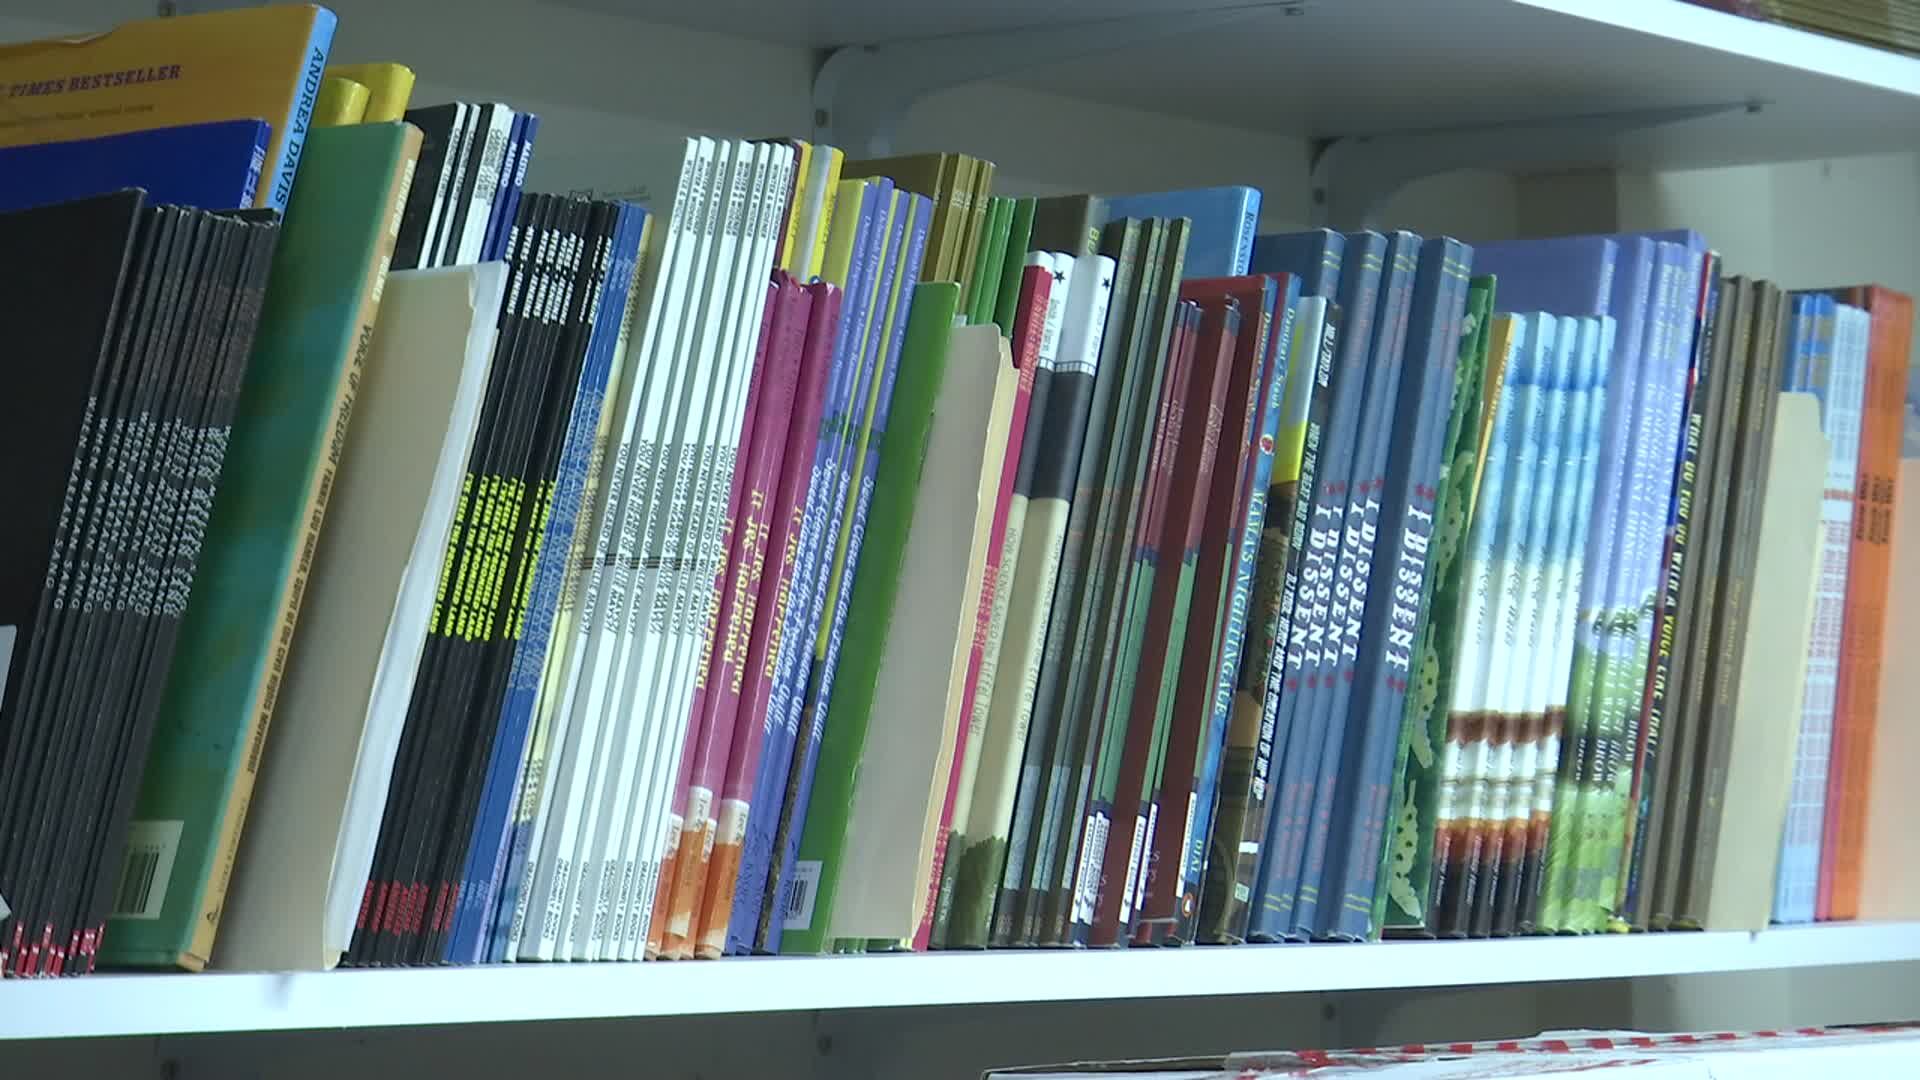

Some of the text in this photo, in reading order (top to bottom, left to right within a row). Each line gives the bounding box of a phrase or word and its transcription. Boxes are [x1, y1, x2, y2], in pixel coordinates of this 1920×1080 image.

[69, 64, 181, 91] BESTSELLER
[274, 46, 325, 205] ANDREA DAVIS
[501, 141, 518, 187] MAESTRO
[514, 139, 533, 187] MAESTRO
[1305, 421, 1320, 452] WHEN
[1685, 412, 1702, 455] WHAT
[617, 441, 629, 465] YOU
[660, 442, 671, 465] YOU
[702, 443, 714, 467] YOU
[1302, 451, 1316, 472] THE
[44, 394, 97, 589] WHEN MARIAN SANG
[609, 466, 624, 501] NEVER
[653, 466, 666, 501] NEVER
[695, 468, 709, 502] NEVER
[832, 469, 851, 516] Sweet
[855, 474, 874, 525] Sweet
[1298, 472, 1312, 498] BEAT
[52, 416, 108, 610] WHEN MARIAN SANG
[70, 416, 124, 610] WHEN MARIAN SANG
[82, 420, 136, 614] WHEN MARIAN SANG
[102, 420, 156, 613] WHEN MARIAN SANG
[115, 420, 171, 611] WHEN MARIAN SANG
[308, 508, 323, 531] LOU
[455, 494, 468, 522] SEEN
[471, 497, 483, 526] SEEN
[509, 503, 521, 531] SEEN
[601, 502, 616, 538] HEARD
[645, 502, 659, 539] HEARD
[687, 503, 702, 540] HEARD
[449, 523, 461, 545] THE
[465, 527, 476, 548] THE
[503, 532, 514, 553] THE
[598, 539, 608, 554] OF
[642, 540, 652, 554] OF
[684, 541, 694, 555] OF
[822, 517, 840, 562] Clara
[845, 523, 863, 570] Clara
[1003, 526, 1016, 555] HOW
[1290, 519, 1305, 552] BORN
[435, 545, 456, 601] PROMISED
[451, 548, 471, 605] PROMISED
[490, 553, 509, 609] PROMISED
[590, 555, 604, 591] WILLIE
[635, 556, 648, 591] WILLIE
[677, 557, 691, 592] WILLIE
[815, 562, 831, 594] and
[839, 568, 854, 600] and
[994, 555, 1010, 602] SCIENCE
[1284, 571, 1297, 589] DJ
[1284, 503, 1332, 670] I DISSENT
[1322, 501, 1365, 667] I DISSENT
[1341, 496, 1380, 661] I DISSENT
[427, 602, 441, 634] LAND
[809, 594, 824, 622] the
[833, 599, 848, 627] the
[1280, 588, 1295, 616] KOOL
[443, 605, 457, 638] LAND
[482, 610, 495, 641] LAND
[987, 603, 1002, 638] SAVED
[794, 622, 818, 690] Freedom
[1213, 568, 1250, 717] NIGHTINGALE
[1271, 645, 1286, 669] AND
[819, 628, 841, 696] Freedom
[1268, 670, 1282, 691] THE
[1260, 690, 1279, 742] CREATION
[1257, 740, 1271, 756] OF
